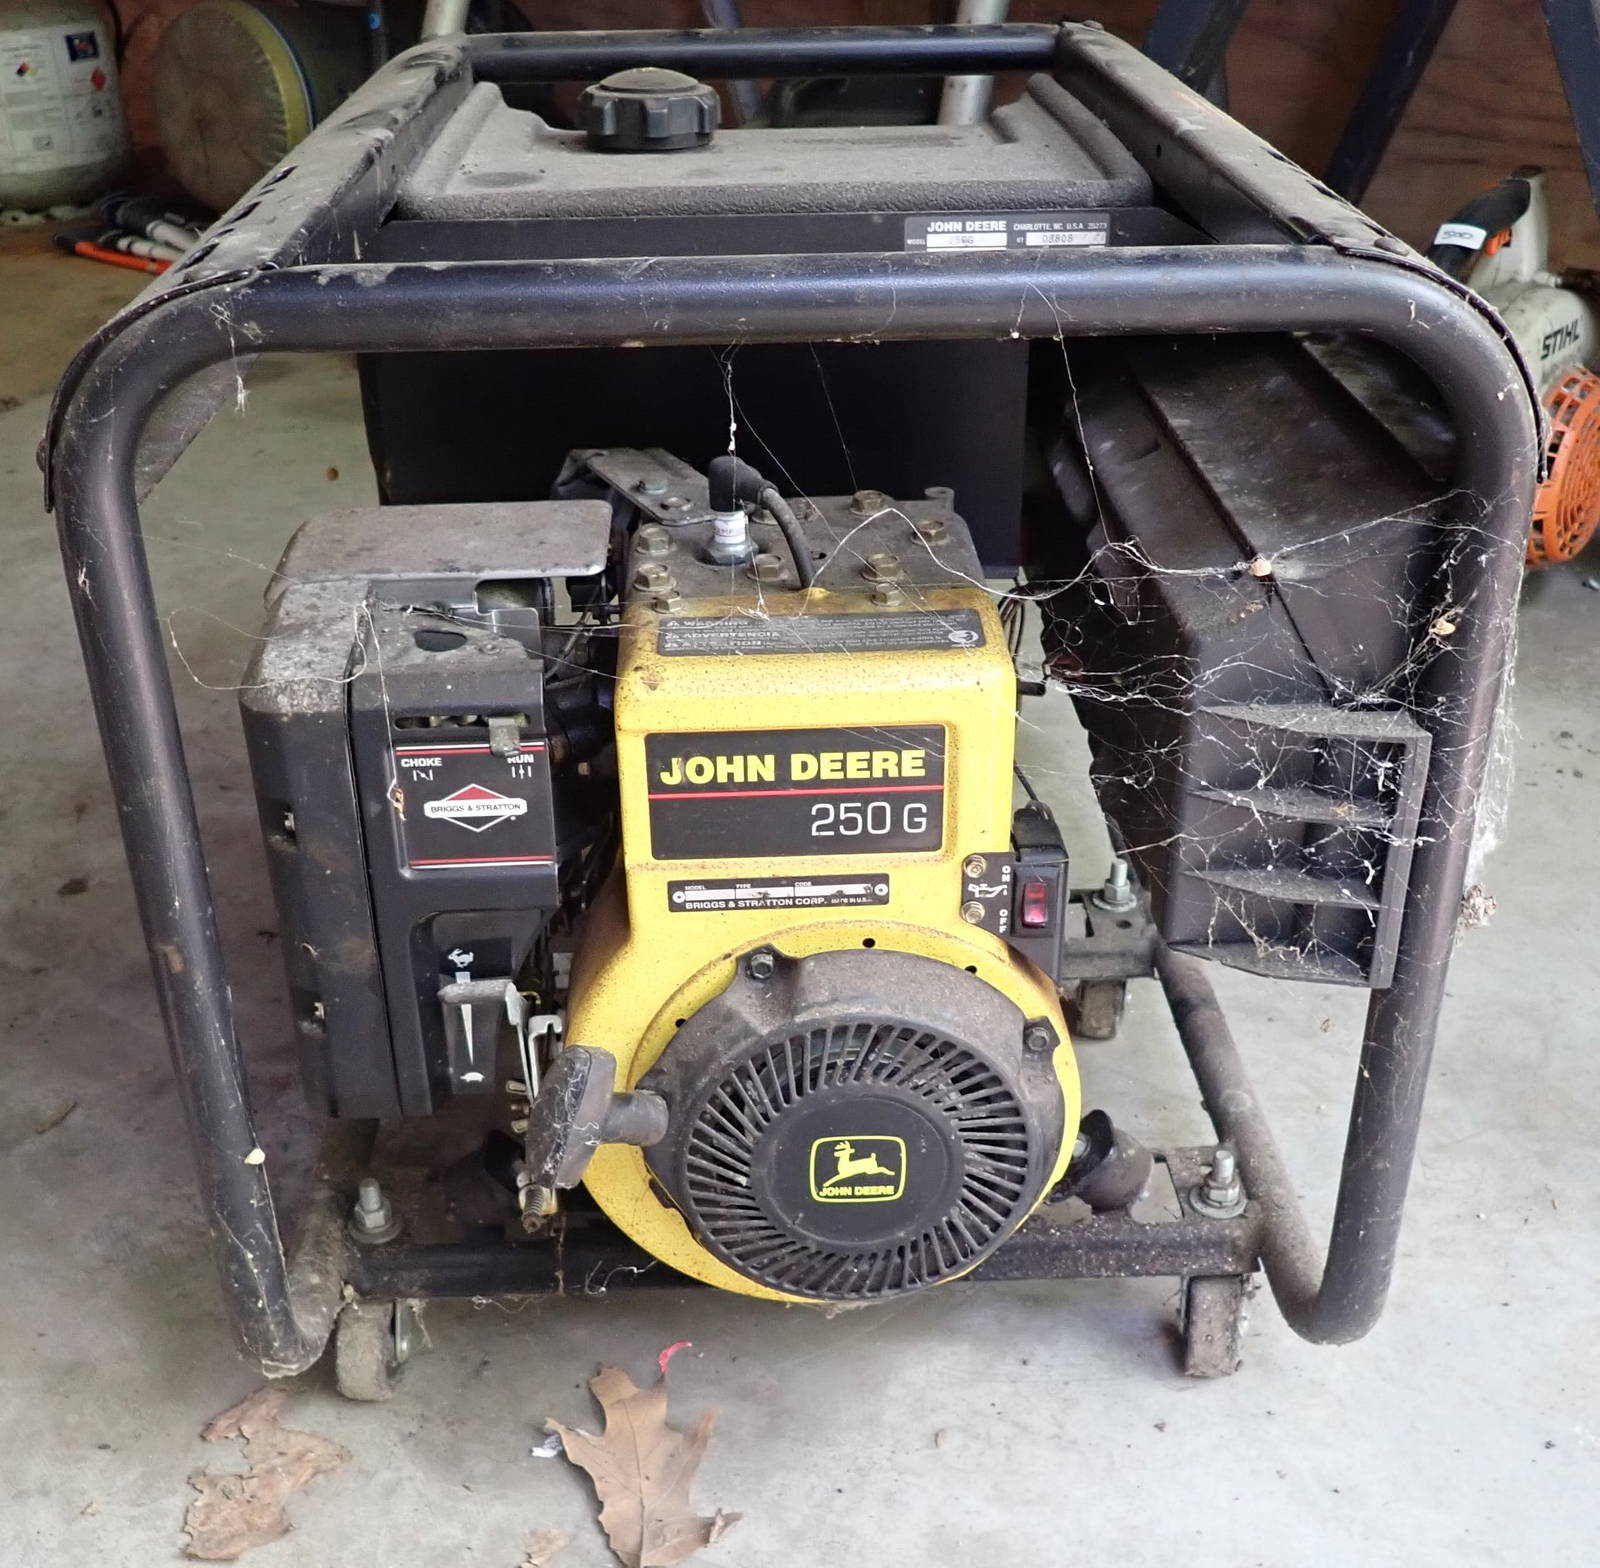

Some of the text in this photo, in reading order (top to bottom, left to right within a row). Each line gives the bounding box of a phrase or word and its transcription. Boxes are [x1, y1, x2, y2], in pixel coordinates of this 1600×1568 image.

[927, 220, 1007, 232] JOHN DEERE
[1540, 318, 1580, 360] STIHL
[401, 757, 442, 767] CHOKE
[507, 754, 534, 764] RUN
[659, 749, 926, 786] JOHN DEERE
[430, 803, 521, 814] BRIGGS & STRATTON
[811, 801, 928, 837] 250 G
[1001, 865, 1011, 882] ON
[685, 900, 726, 910] BRIGGS
[728, 900, 736, 908] &
[737, 898, 793, 908] STRATTON
[795, 897, 828, 906] CORP.
[999, 909, 1008, 934] OFF
[819, 1185, 895, 1196] JOHN DEERE
